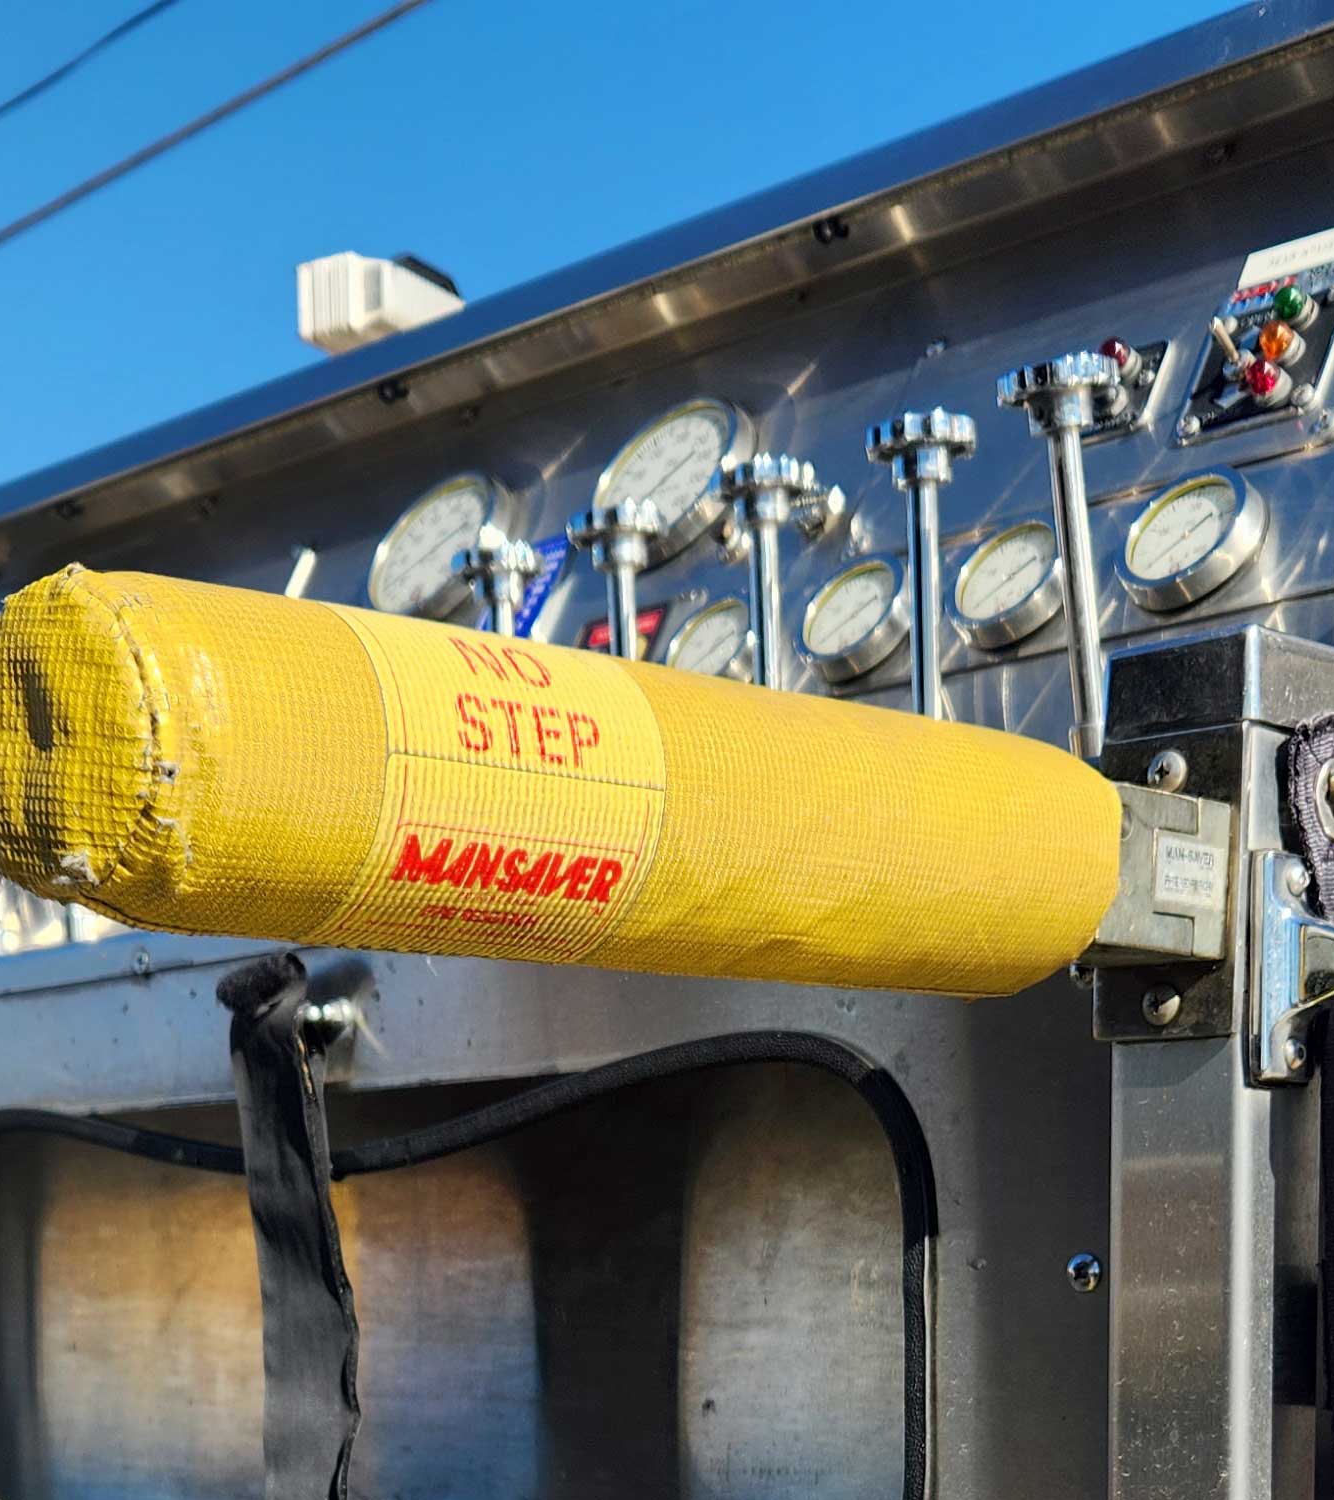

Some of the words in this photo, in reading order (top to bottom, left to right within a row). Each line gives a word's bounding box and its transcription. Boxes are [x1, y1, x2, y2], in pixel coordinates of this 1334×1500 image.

[449, 637, 551, 688] NO
[455, 692, 601, 769] STEP
[391, 834, 622, 903] MANSAVER
